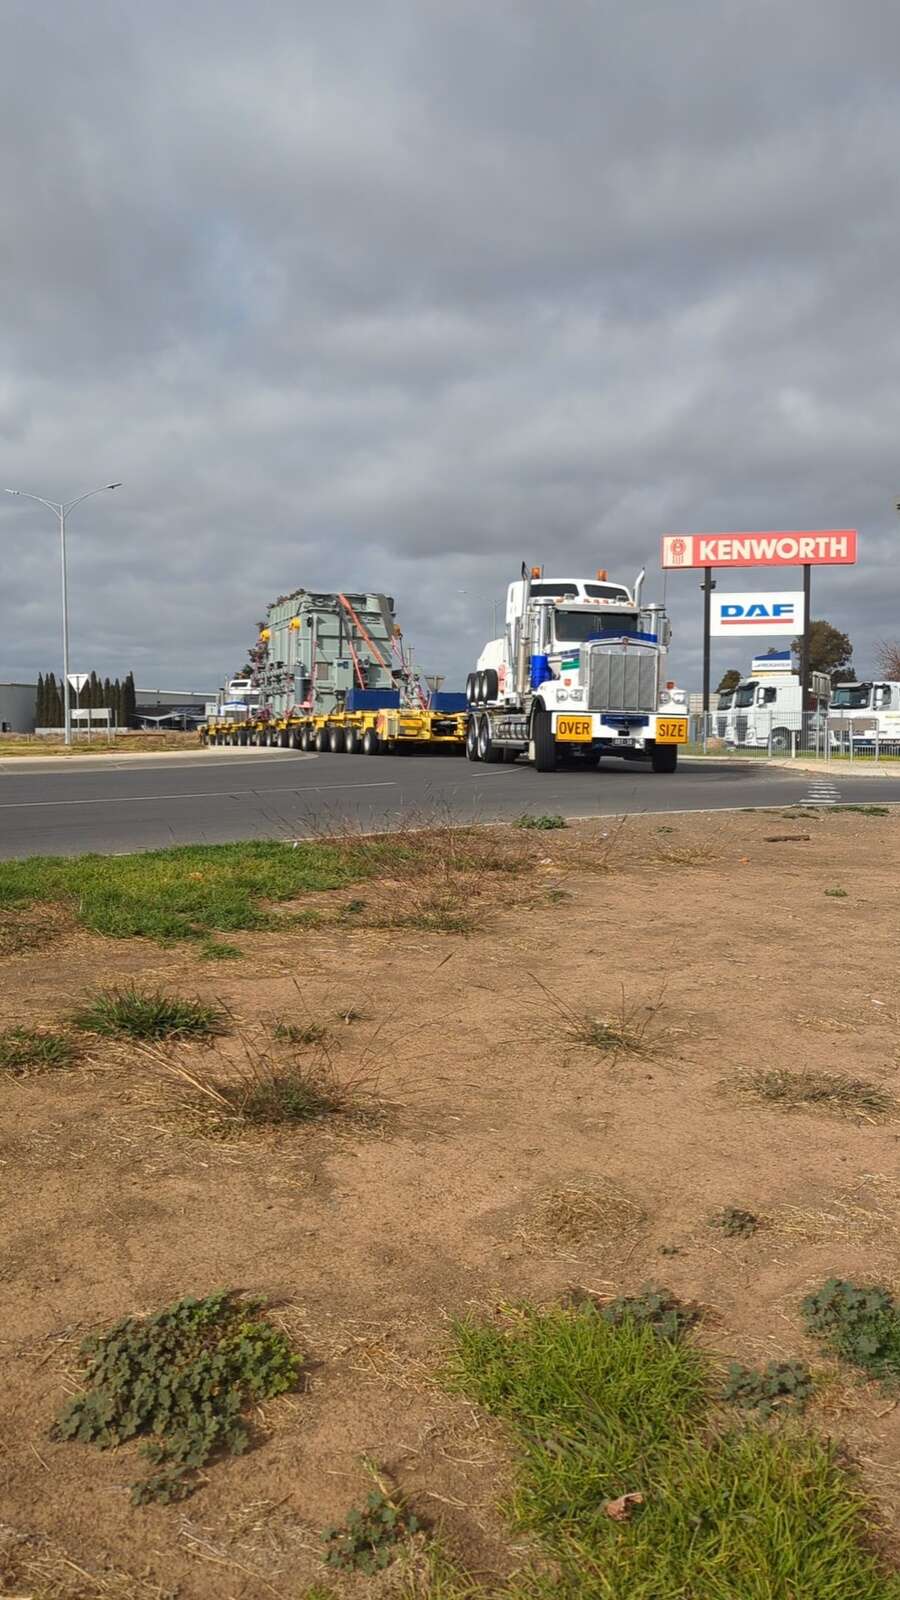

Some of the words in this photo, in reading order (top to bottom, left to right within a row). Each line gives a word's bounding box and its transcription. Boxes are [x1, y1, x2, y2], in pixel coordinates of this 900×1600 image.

[700, 536, 848, 561] KENWORTH
[720, 603, 795, 618] DAF
[559, 721, 591, 735] OVER
[658, 723, 685, 738] SIZE
